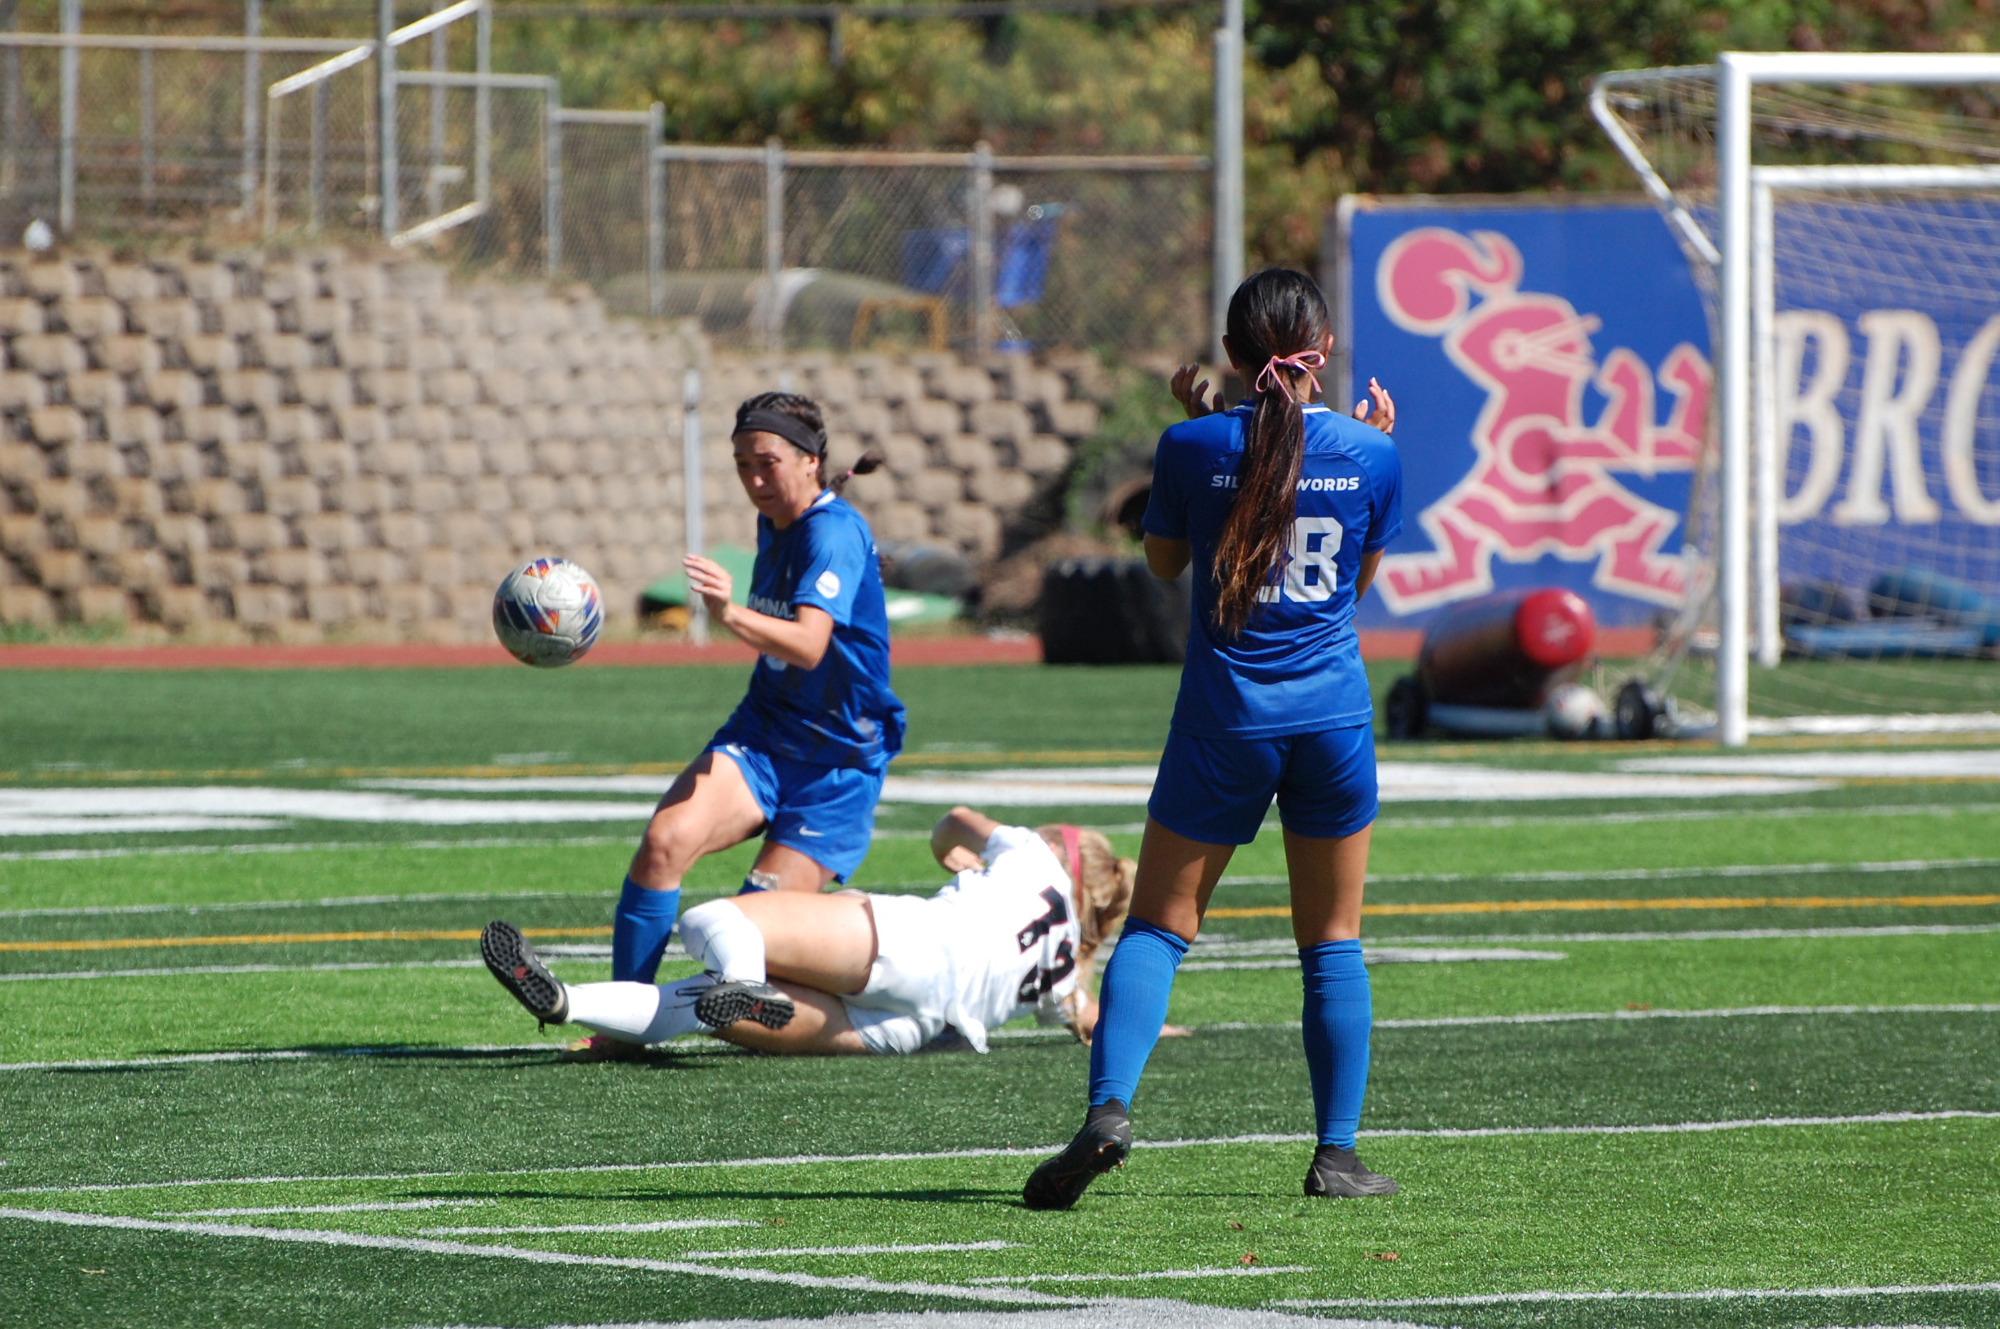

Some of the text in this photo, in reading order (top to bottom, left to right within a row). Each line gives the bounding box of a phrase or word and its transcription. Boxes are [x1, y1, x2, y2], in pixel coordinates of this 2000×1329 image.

[1211, 475, 1360, 492] SILWORDS
[1252, 516, 1343, 604] 8
[1016, 884, 1076, 1005] 12
